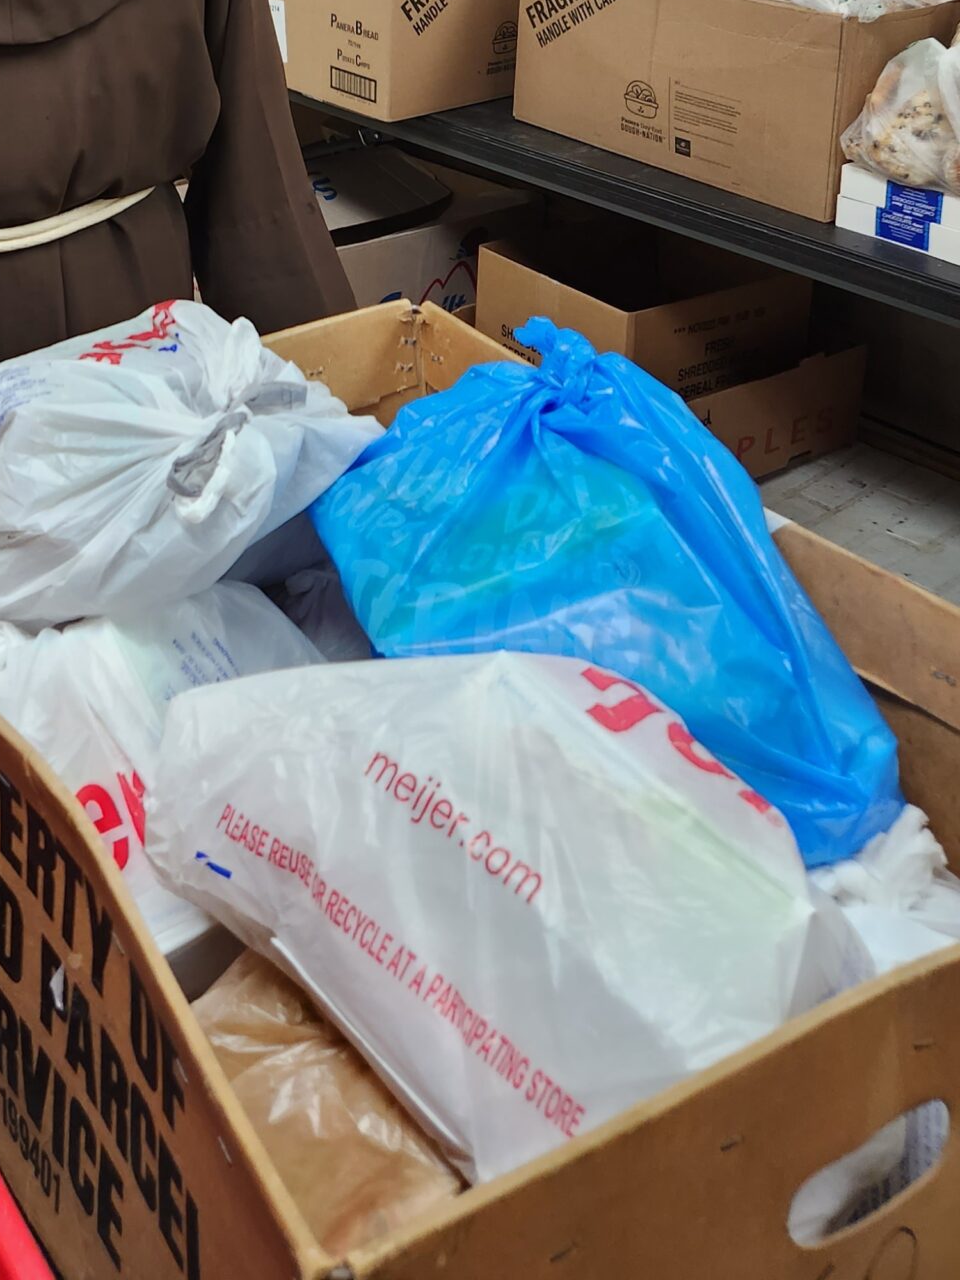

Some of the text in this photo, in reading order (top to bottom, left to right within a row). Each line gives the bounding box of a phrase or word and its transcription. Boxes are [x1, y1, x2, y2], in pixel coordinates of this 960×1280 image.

[536, 14, 572, 49] HANDLE
[568, 0, 595, 27] WITH
[364, 751, 542, 905] meijer.com
[129, 959, 185, 1131] OF
[217, 803, 269, 858] PLEASE
[269, 838, 314, 888] REUSE
[325, 889, 394, 966] RECYCLE
[387, 945, 417, 981] AT
[409, 965, 426, 995] A
[525, 1070, 586, 1138] STORE
[0, 1087, 61, 1214] 199401
